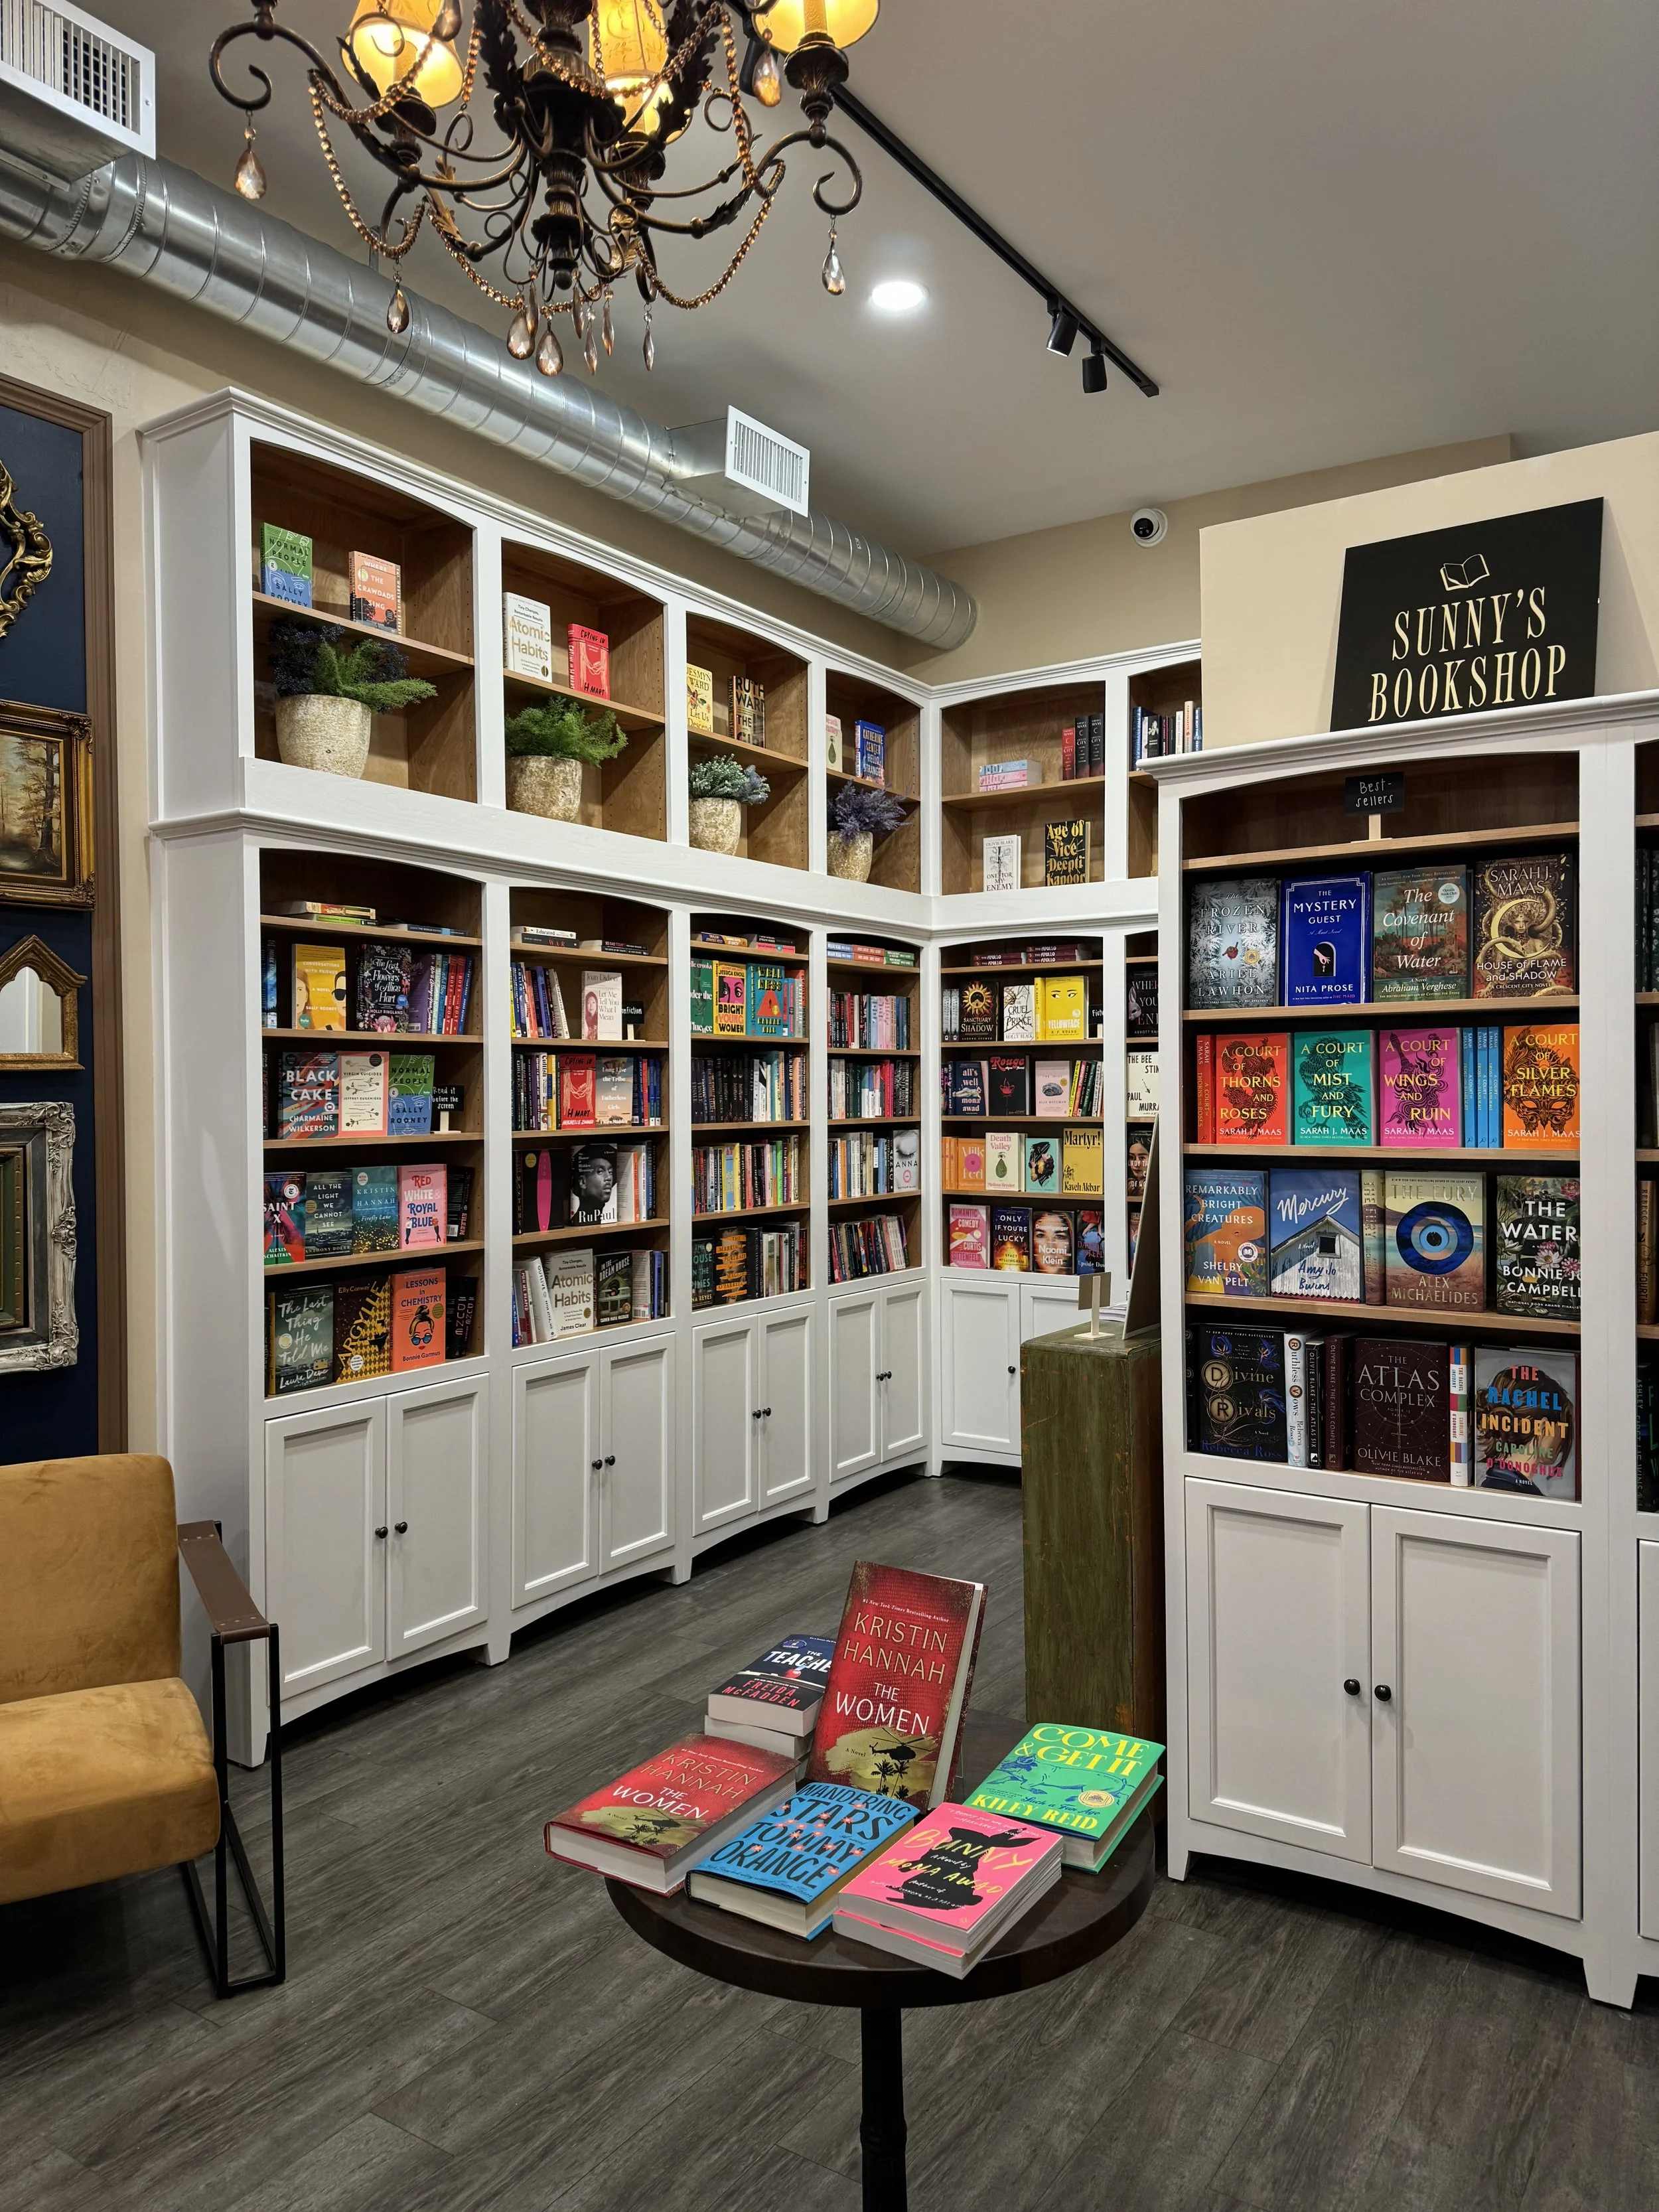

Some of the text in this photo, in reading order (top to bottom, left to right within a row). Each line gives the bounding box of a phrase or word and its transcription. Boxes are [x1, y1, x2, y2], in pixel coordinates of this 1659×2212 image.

[269, 538, 309, 556] NORMAL
[273, 550, 306, 567] PEOPLE
[364, 561, 388, 572] WHERE
[370, 575, 384, 585] THE
[275, 583, 303, 597] SALLY
[358, 584, 395, 601] CRAWDADS
[367, 599, 386, 610] SING
[508, 616, 550, 642] Atomic
[1392, 587, 1545, 661] SUNNY'S
[512, 638, 548, 662] Habits
[686, 667, 711, 682] JESMYN
[584, 682, 605, 696] H MART
[689, 678, 709, 692] WARD
[735, 676, 764, 697] RUTH
[1368, 644, 1565, 722] BOOKSHOP
[1356, 795, 1393, 807] sellers
[1046, 820, 1084, 842] Age of
[1052, 840, 1078, 857] Vice
[1047, 855, 1084, 873] Deepti
[1046, 873, 1085, 886] Kapoor
[986, 883, 1013, 891] ENEMY
[1497, 881, 1546, 897] MAAS
[1404, 889, 1433, 904] The
[1201, 904, 1265, 918] FROZEN
[1293, 899, 1357, 913] MYSTERY
[1308, 915, 1341, 924] GUEST
[1382, 910, 1455, 927] Covenant
[1207, 922, 1258, 934] RIVER
[1396, 955, 1441, 968] Water
[1477, 958, 1567, 971] HOUSE of FLAME
[1206, 968, 1256, 980] ARIEL
[1486, 971, 1556, 982] and SHADOW
[1198, 985, 1265, 996] LAWHON
[1295, 984, 1354, 994] NITA PROSE
[1382, 982, 1457, 993] Abraham Verghese
[718, 1004, 744, 1014] BRIGHT
[719, 1023, 744, 1033] WOMEN
[961, 1023, 993, 1033] SHADOW
[1048, 1019, 1080, 1029] YELLOWFACE
[1385, 1040, 1450, 1052] A COURT
[1510, 1033, 1578, 1046] A COURT
[1221, 1046, 1281, 1057] A COURT
[1301, 1042, 1365, 1055] A COURT
[989, 1056, 1025, 1072] Rouge
[286, 1070, 336, 1082] BLACK
[1313, 1073, 1352, 1086] MIST
[1384, 1074, 1438, 1086] WINGS
[1516, 1067, 1571, 1080] SILVER
[962, 1077, 978, 1086] well
[1220, 1076, 1281, 1088] THORNS
[291, 1088, 332, 1101] CAKE
[1511, 1084, 1576, 1097] FLAMES
[289, 1114, 333, 1123] CHARMAINE
[1220, 1108, 1267, 1119] ROSES
[1311, 1106, 1355, 1118] FURY
[1410, 1108, 1451, 1120] RUIN
[1064, 1130, 1100, 1149] Martyr!
[990, 1143, 1011, 1151] Valley
[411, 1175, 431, 1188] RED
[1186, 1185, 1258, 1195] REMARKABLY
[1392, 1185, 1477, 1201] THE FURY
[357, 1198, 395, 1207] HANNAH
[407, 1203, 438, 1215] ROYAL
[1202, 1199, 1242, 1209] BRIGHT
[1277, 1187, 1349, 1224] Mercury
[1525, 1201, 1566, 1218] THE
[579, 1208, 614, 1223] RuPaul
[1191, 1215, 1253, 1224] CREATURES
[1039, 1245, 1067, 1254] Naomi
[1043, 1256, 1063, 1265] Klein
[1204, 1261, 1242, 1272] SHELBY
[405, 1278, 439, 1289] LESSONS
[551, 1271, 593, 1289] Atomic
[1198, 1276, 1250, 1287] VAN PELT
[1418, 1276, 1450, 1289] ALEX
[401, 1295, 443, 1307] CHEMISTRY
[555, 1291, 591, 1307] Habits
[1388, 1355, 1407, 1365] THE
[1356, 1364, 1440, 1392] ATLAS
[1508, 1366, 1539, 1381] THE
[1360, 1388, 1435, 1408] COMPLEX
[1487, 1386, 1562, 1411] RACHEL
[1481, 1413, 1569, 1439] INCIDENT
[1202, 1440, 1282, 1458] Rebecca Ross
[1495, 1441, 1553, 1459] CAROLINE
[1358, 1447, 1441, 1467] OLIVIE BLAKE
[1486, 1457, 1563, 1478] O'DONOGHUE
[853, 1611, 948, 1654] KRISTIN
[843, 1640, 946, 1684] HANNAH
[743, 1680, 797, 1696] FREIDA
[874, 1682, 901, 1702] THE
[836, 1692, 930, 1735] WOMEN
[1033, 1726, 1150, 1759] COME
[1013, 1741, 1142, 1777] & GET IT
[662, 1753, 757, 1787] KRISTIN
[640, 1764, 745, 1800] HANNAH
[613, 1785, 710, 1820] WOMEN
[799, 1782, 914, 1822] WANDERING
[1021, 1796, 1046, 1807] Such
[1058, 1804, 1078, 1812] Fun
[1078, 1806, 1100, 1816] Age
[769, 1797, 895, 1841] STARS
[971, 1795, 1098, 1830] KILEY REID
[743, 1822, 865, 1864] TOMMY
[903, 1828, 1033, 1871] BUNNY
[709, 1840, 838, 1889] ORANGE
[879, 1858, 1003, 1894] MONA AWAD
